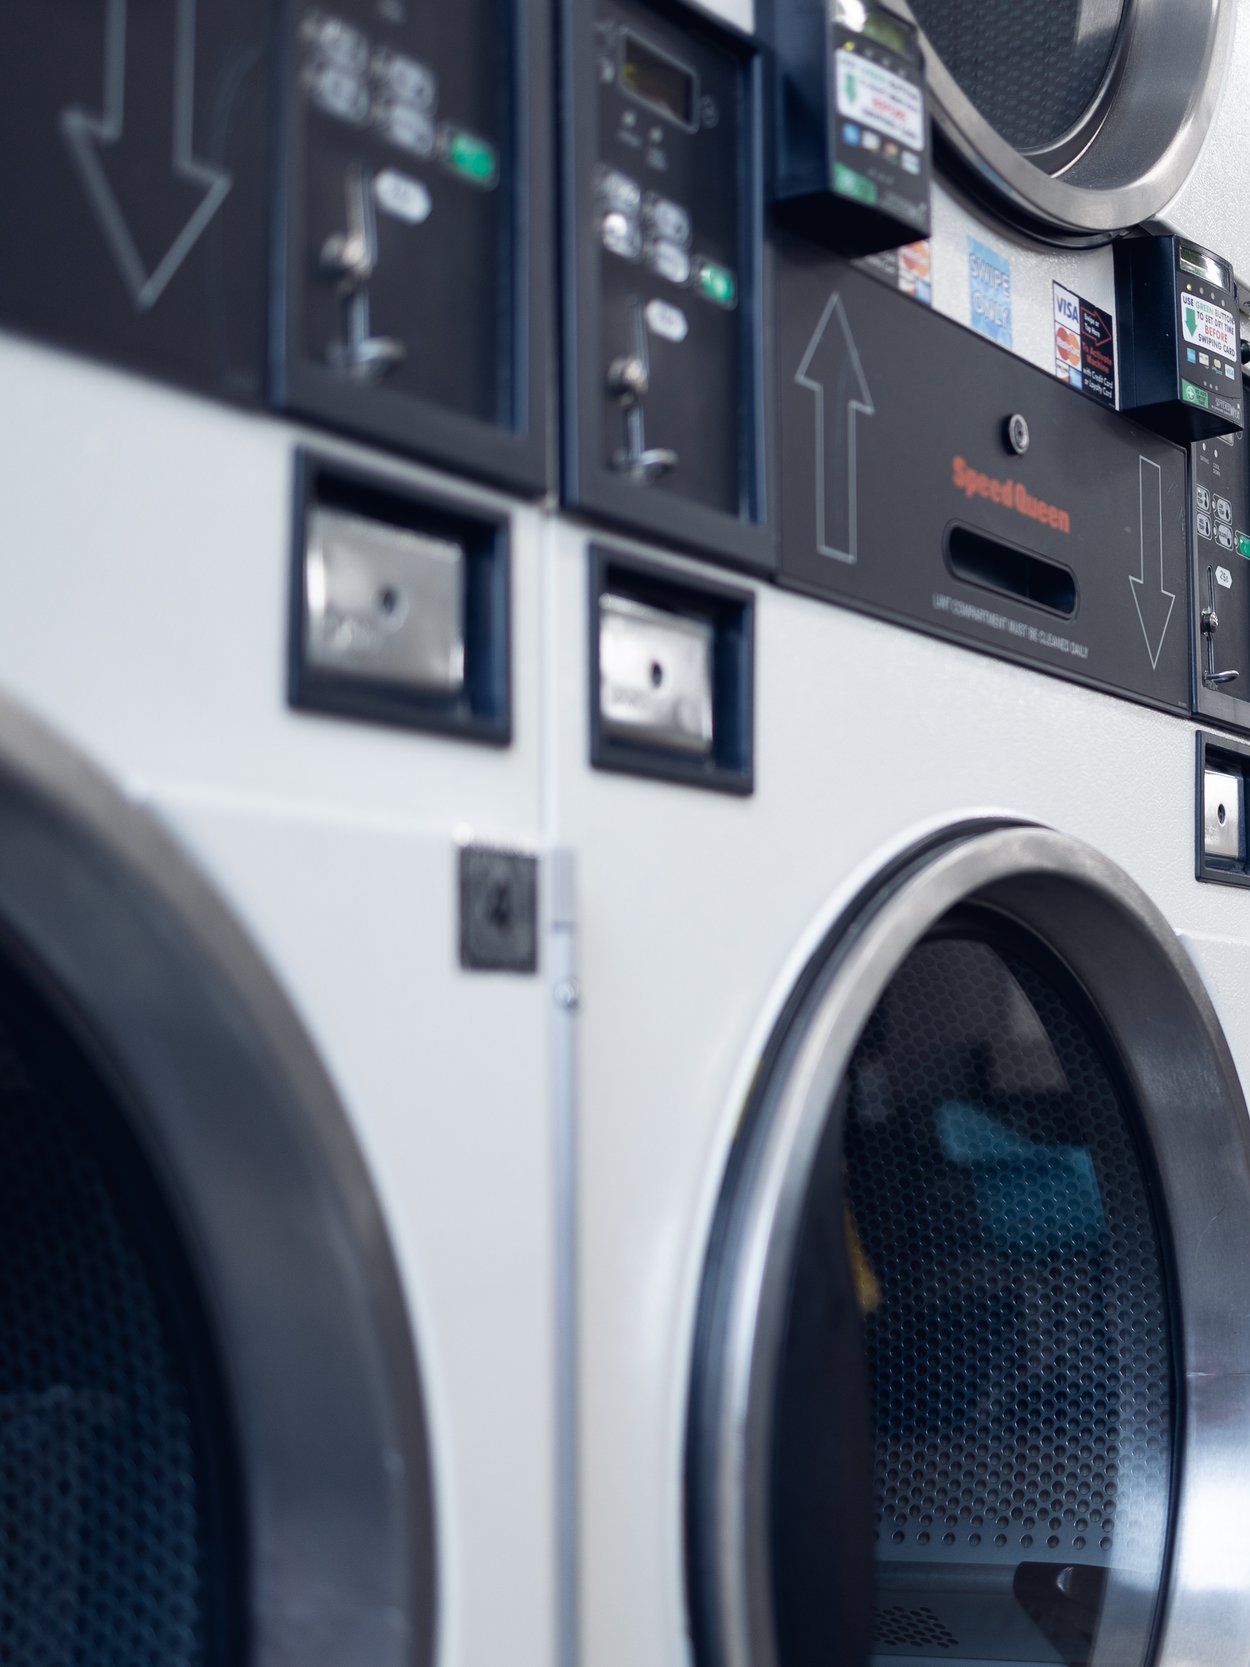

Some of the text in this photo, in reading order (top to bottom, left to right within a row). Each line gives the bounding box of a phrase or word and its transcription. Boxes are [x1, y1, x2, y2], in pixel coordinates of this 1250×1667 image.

[969, 252, 1010, 297] SWIPE
[971, 290, 1009, 328] ONLY
[1056, 295, 1079, 323] VISA
[1183, 296, 1235, 325] USE GREEN BUTTON
[1197, 311, 1234, 336] TO SET DRY TIME
[1205, 325, 1228, 343] BEFORE
[1198, 333, 1235, 357] SWIPING CARD
[1102, 387, 1113, 398] Card
[1103, 377, 1113, 389] Card
[952, 455, 1070, 534] Speed Queen
[951, 597, 1008, 632] COMPARTMENT
[1008, 618, 1028, 637] MUST
[1039, 629, 1070, 653] CLEANED
